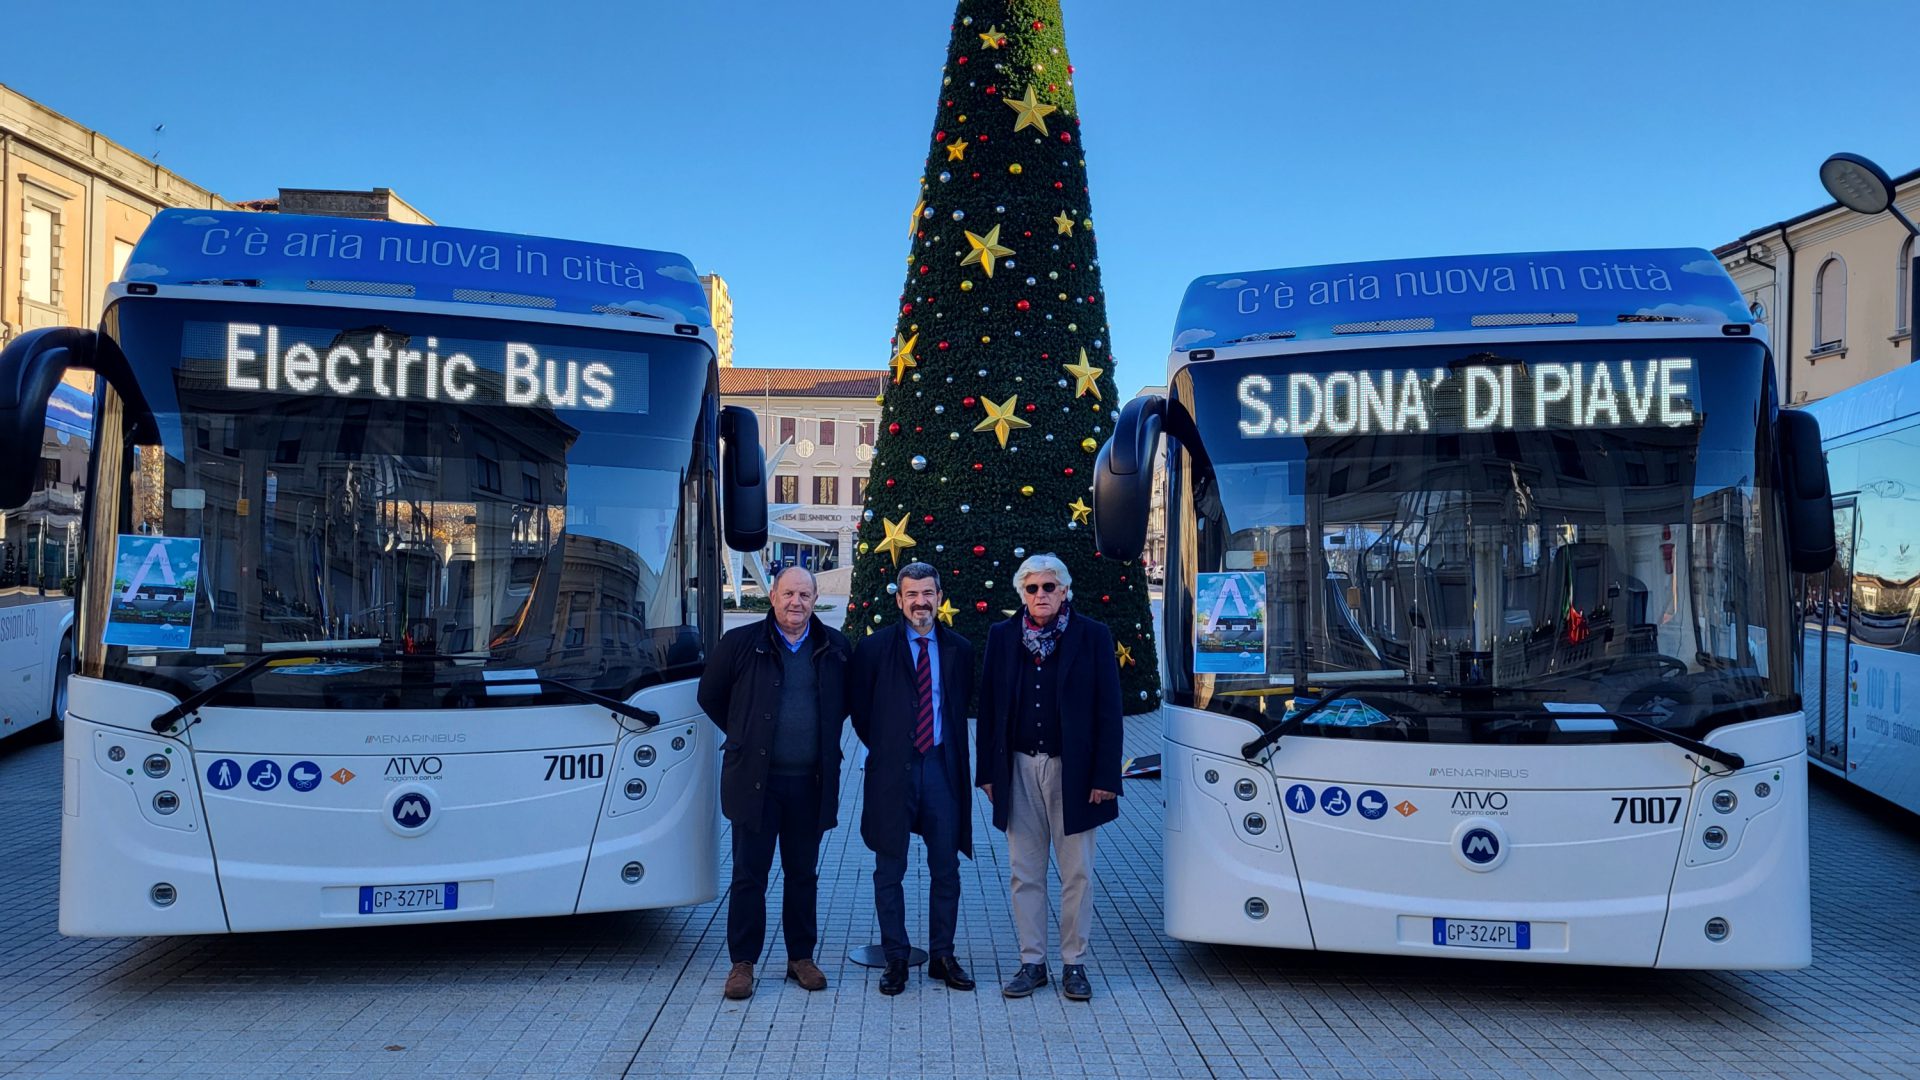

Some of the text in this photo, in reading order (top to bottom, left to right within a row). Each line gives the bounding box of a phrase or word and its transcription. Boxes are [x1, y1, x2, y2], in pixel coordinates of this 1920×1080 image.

[283, 229, 363, 260] aria
[379, 236, 500, 271] nuova
[515, 244, 548, 276] in
[562, 255, 645, 290] città
[1309, 273, 1380, 305] aria
[1395, 265, 1516, 297] nuova
[1528, 261, 1566, 290] in
[1578, 262, 1673, 291] città
[226, 322, 613, 407] Electric Bus
[1238, 357, 1693, 436] S.DONA' DI PIAVE
[370, 734, 467, 744] MENARINIBUS
[384, 756, 443, 775] ATVO
[543, 753, 604, 781] 7010
[1435, 768, 1529, 778] MENARINIBUS
[1451, 791, 1508, 810] ATVO
[1611, 797, 1682, 824] 7007
